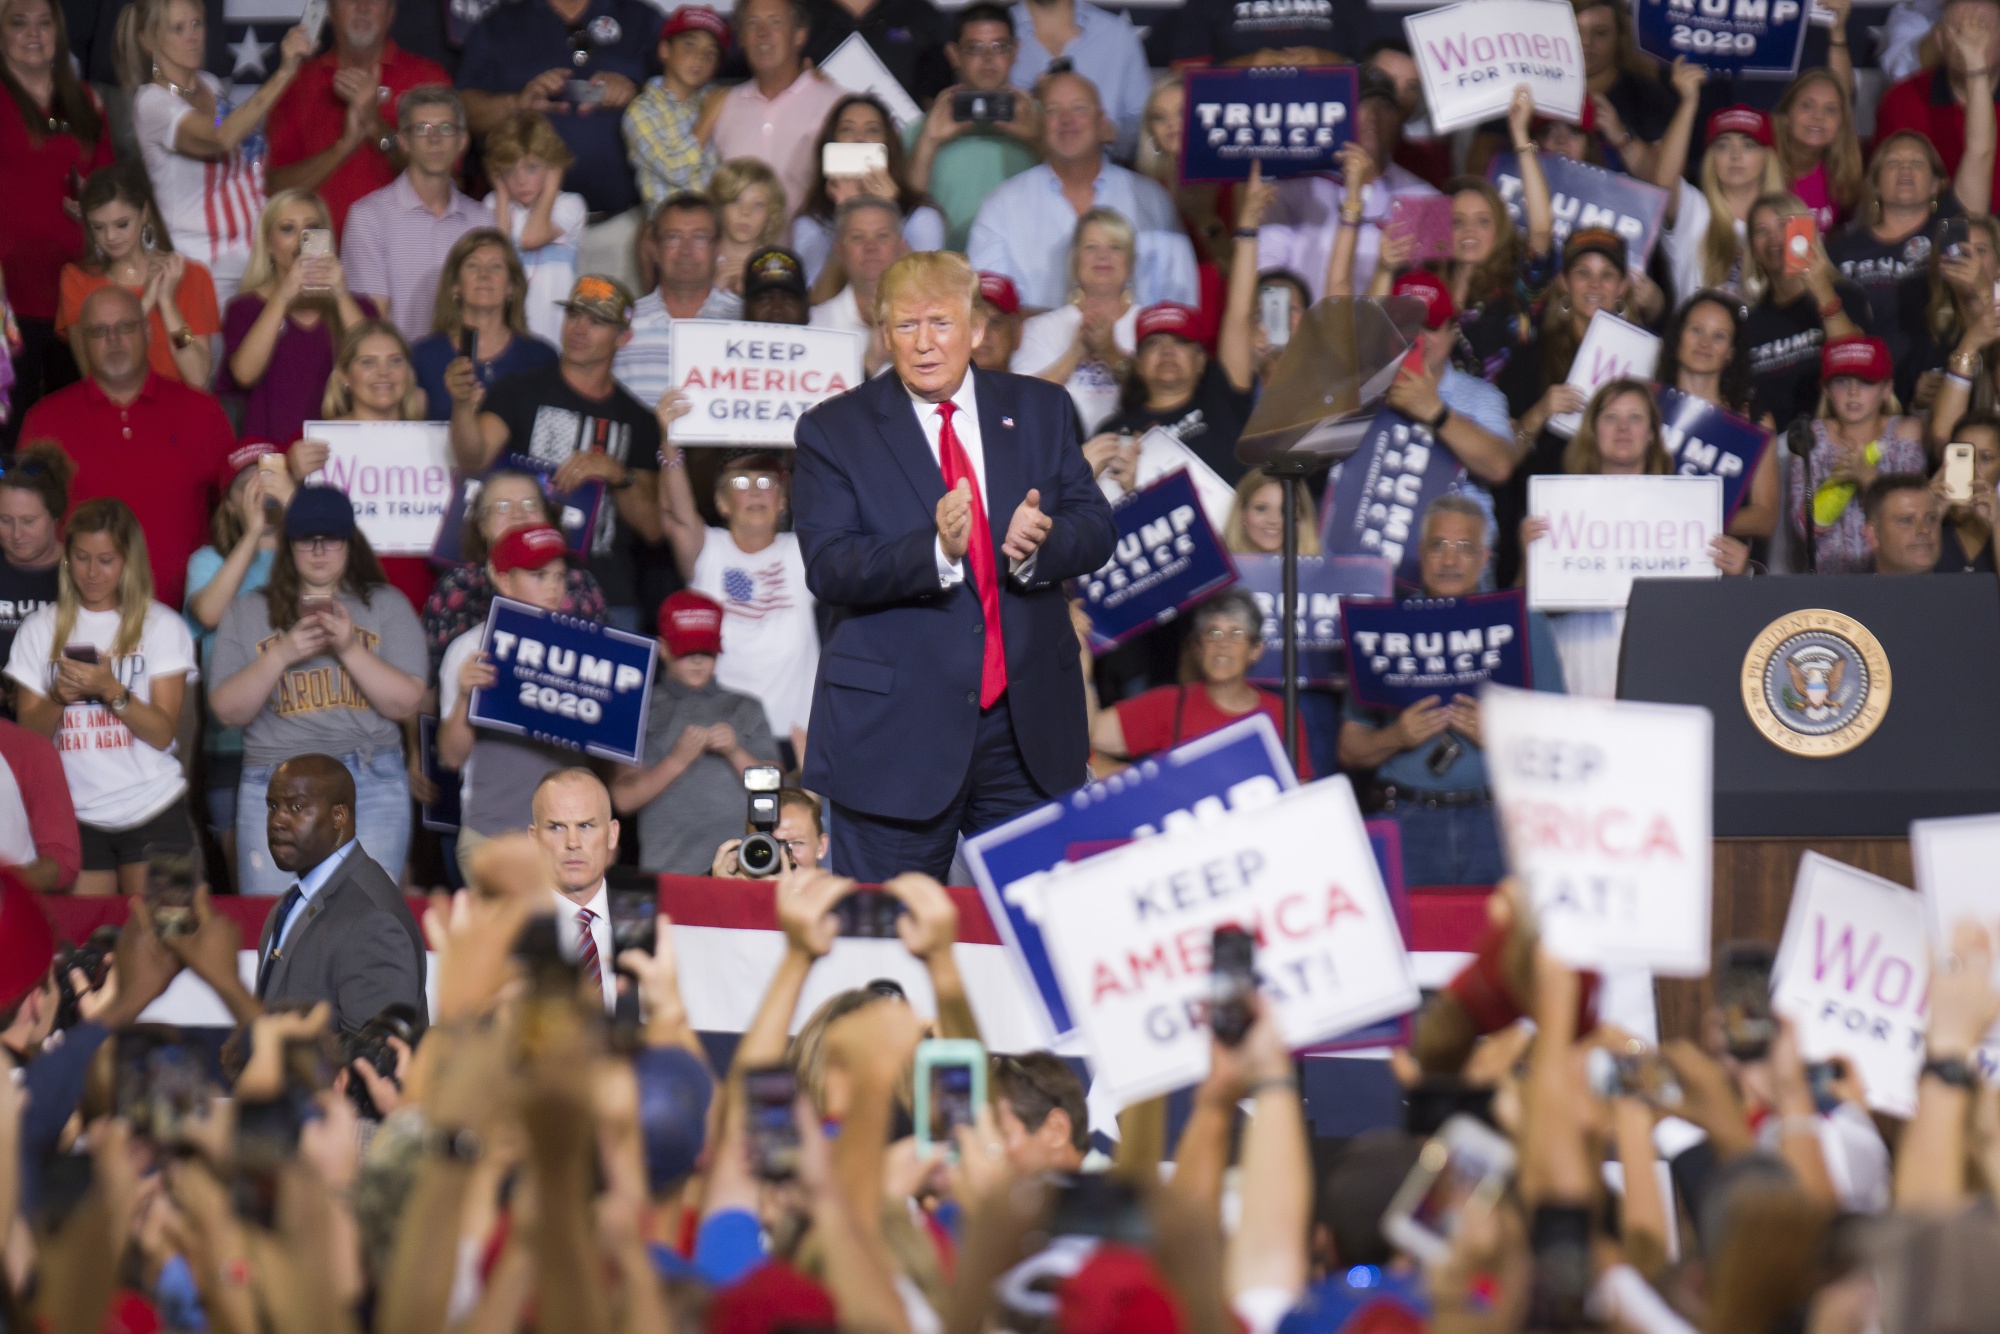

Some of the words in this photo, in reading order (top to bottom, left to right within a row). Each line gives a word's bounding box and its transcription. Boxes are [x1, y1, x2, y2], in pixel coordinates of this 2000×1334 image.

[1234, 0, 1333, 18] TRUMP
[1650, 0, 1800, 25] RUMP
[1427, 32, 1573, 71] Women
[1671, 24, 1757, 56] 2020
[1457, 66, 1500, 87] FOR
[1506, 62, 1565, 81] TRUMP
[1196, 102, 1346, 130] TRUMP
[1207, 127, 1334, 149] PENCE
[1497, 173, 1644, 240] TUMP
[726, 339, 807, 361] KEEP
[682, 366, 850, 394] AMERICA
[1663, 424, 1744, 478] UMP
[322, 455, 445, 497] Wome
[351, 502, 378, 516] OR
[387, 502, 444, 516] TRUM
[1077, 504, 1196, 590] UMP
[1543, 510, 1707, 551] Women
[1088, 533, 1196, 604] PENCE
[1563, 557, 1607, 571] FOR
[1617, 557, 1691, 571] TRUMP
[493, 629, 644, 694] TRUMP
[1353, 624, 1514, 658] TRUMP
[1370, 650, 1502, 675] PENCE
[1748, 615, 1813, 679] PRESIDENT
[1830, 702, 1880, 748] STATES
[519, 681, 603, 725] 2020
[1510, 736, 1607, 785] EEP
[1131, 848, 1265, 922] KEEP
[1091, 882, 1365, 1005] AMEICA
[1145, 949, 1342, 1043] GRAT!
[1818, 1000, 1893, 1042] FOR
